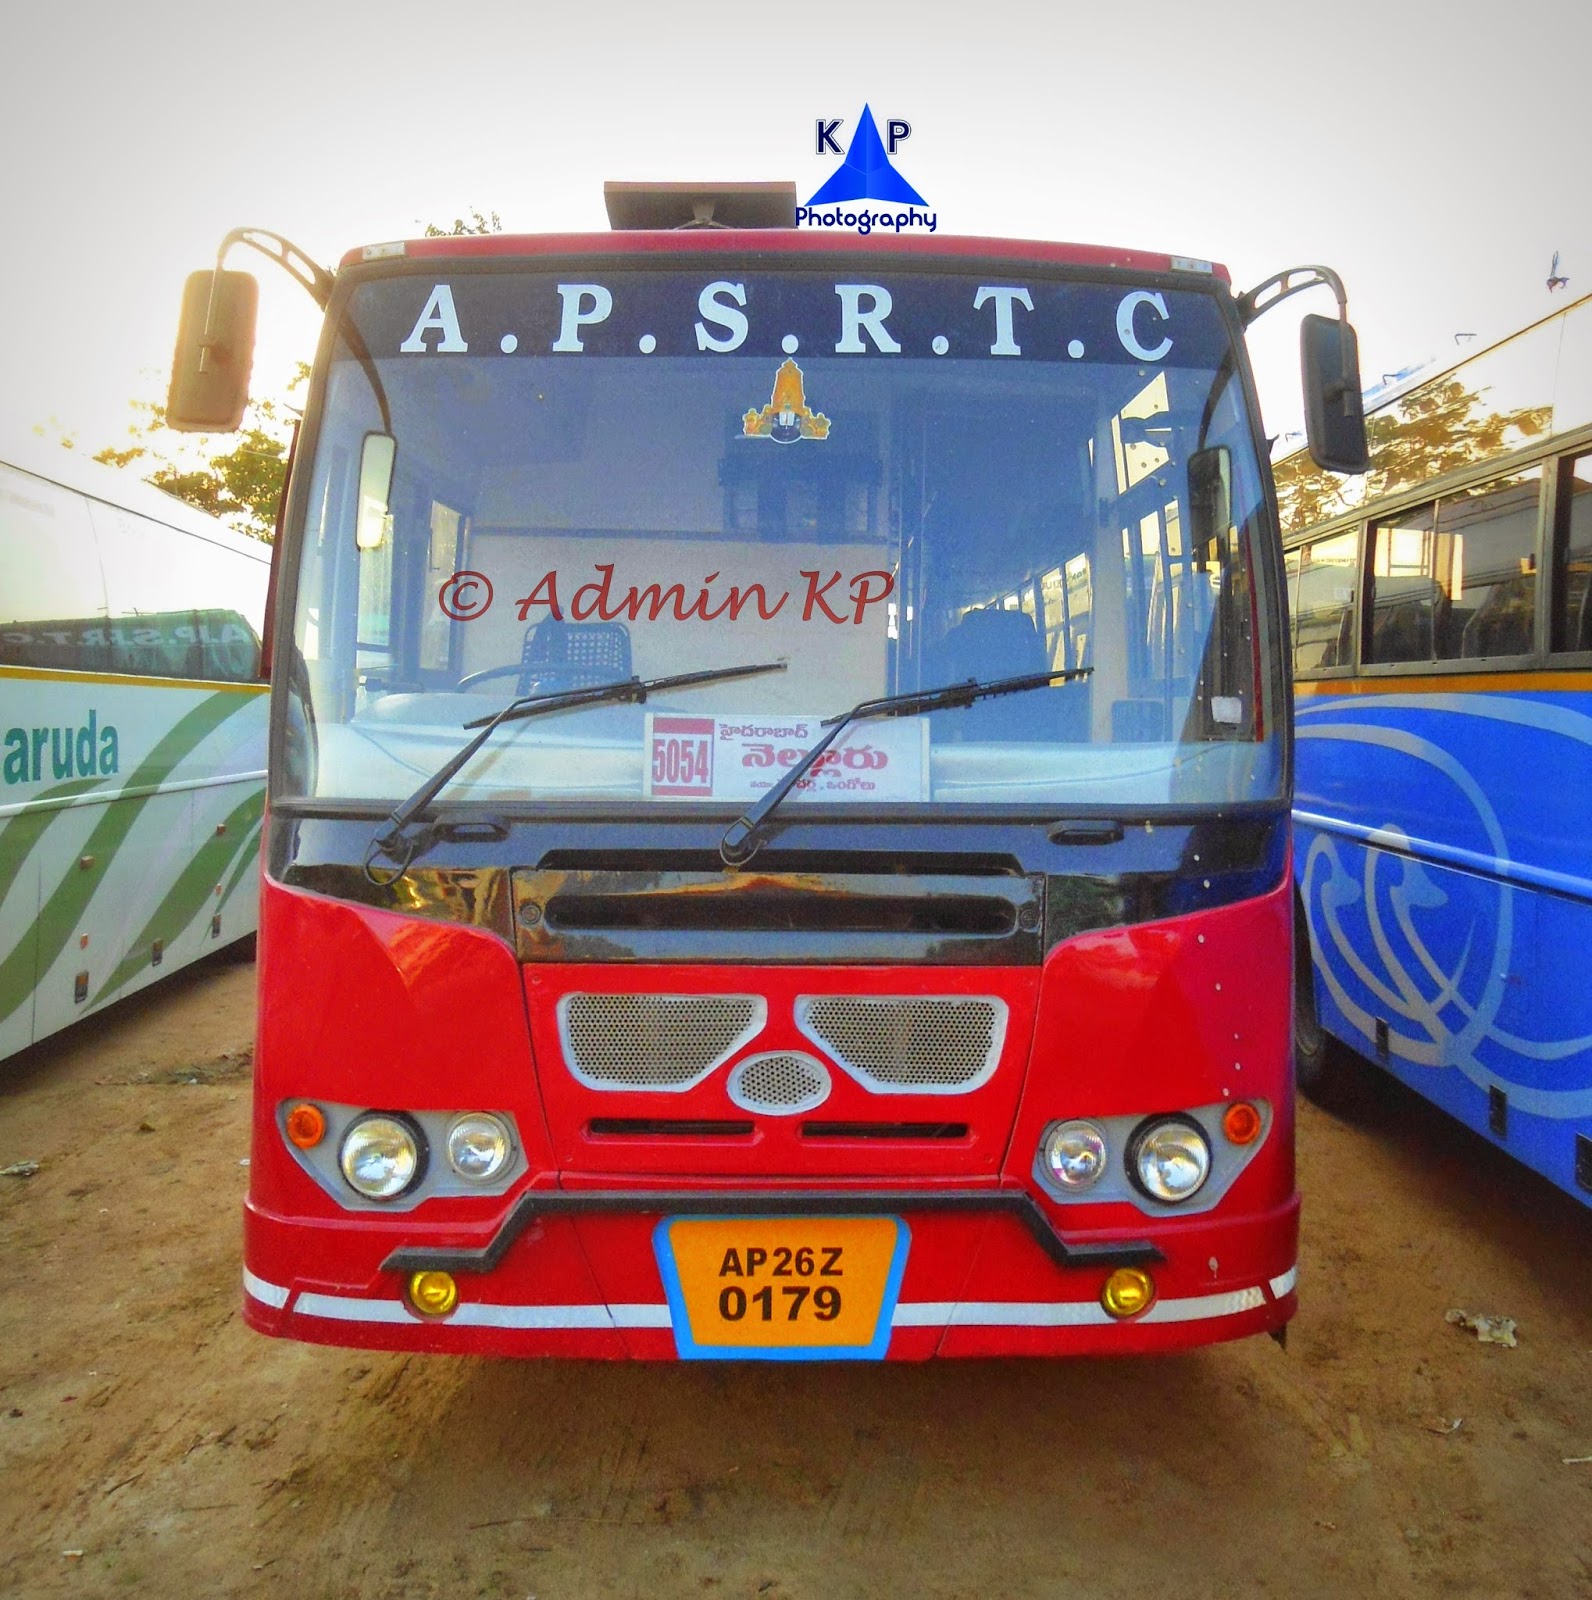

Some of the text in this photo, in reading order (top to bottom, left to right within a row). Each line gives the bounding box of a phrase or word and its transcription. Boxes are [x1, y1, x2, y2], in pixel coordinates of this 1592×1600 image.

[3, 709, 119, 785] aruda
[719, 723, 809, 741] హైదరాబాద్
[652, 739, 709, 783] 5054
[719, 1247, 843, 1277] AP26Z
[719, 1286, 842, 1321] 0179
